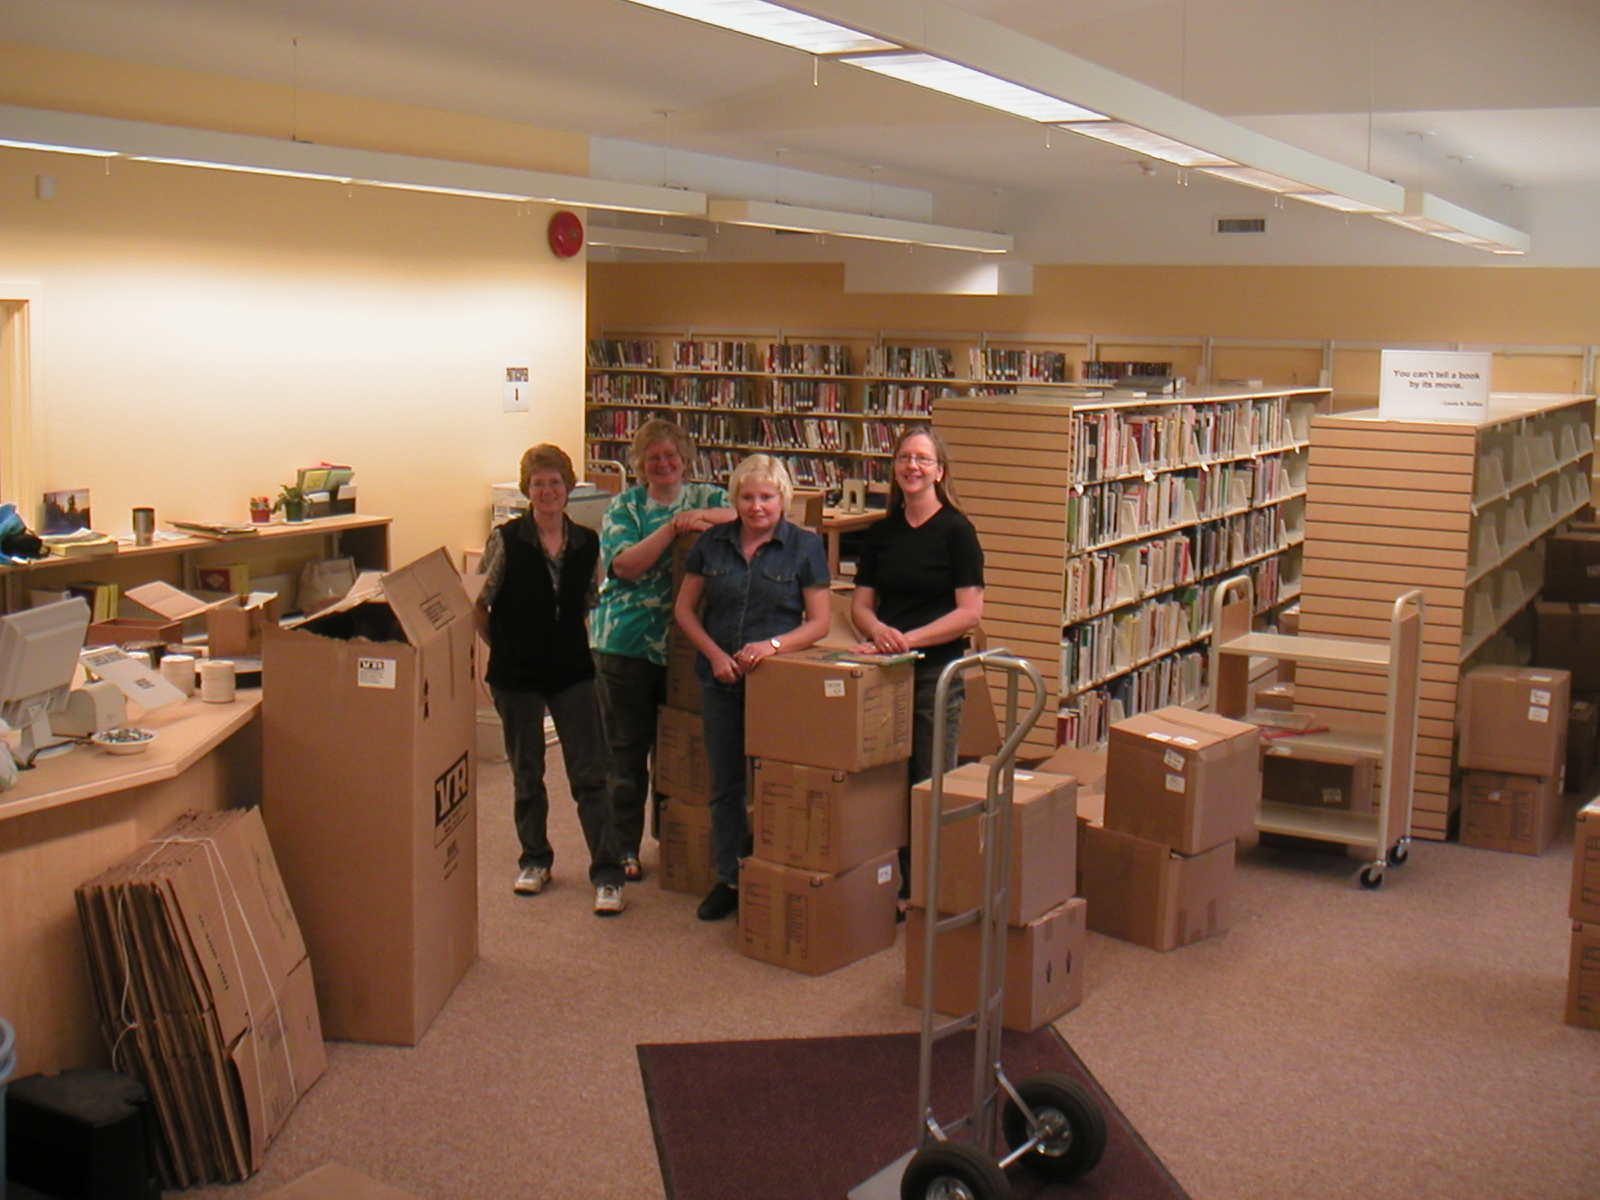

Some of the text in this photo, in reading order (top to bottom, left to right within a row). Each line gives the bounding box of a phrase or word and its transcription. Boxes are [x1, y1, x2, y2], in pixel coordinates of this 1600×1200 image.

[1393, 369, 1411, 378] You
[1412, 370, 1434, 378] can't
[1435, 370, 1449, 379] tell
[1458, 371, 1480, 380] book
[1409, 381, 1419, 390] by
